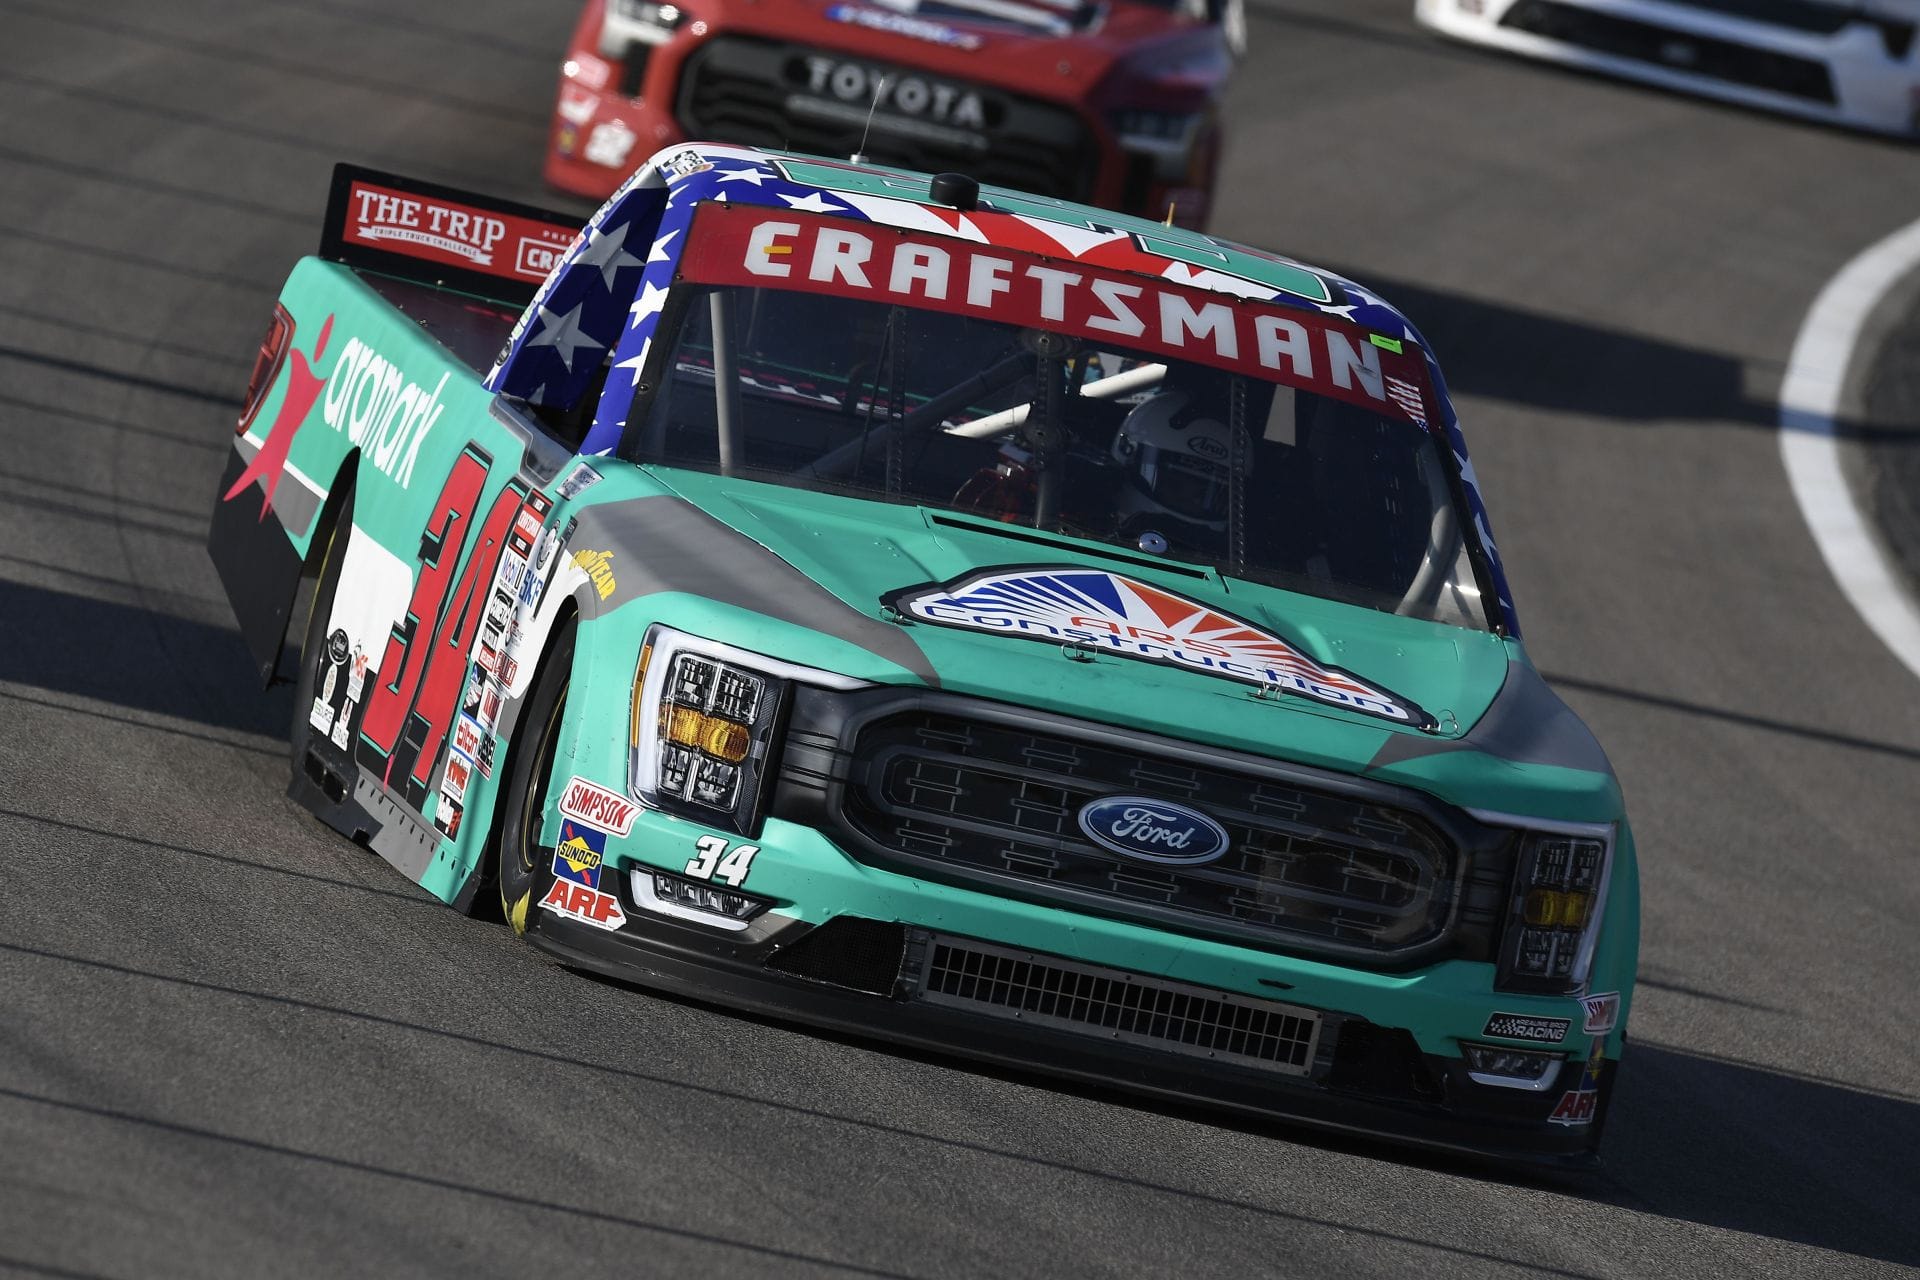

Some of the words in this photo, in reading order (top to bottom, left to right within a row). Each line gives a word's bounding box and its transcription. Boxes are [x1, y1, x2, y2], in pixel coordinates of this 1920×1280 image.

[807, 56, 984, 128] TOYOTA
[355, 189, 419, 227] THE
[426, 205, 506, 252] TRIP
[374, 227, 404, 239] TRIPLE
[405, 231, 431, 243] TRUCK
[744, 221, 1388, 402] CRAFTSMAN
[323, 336, 450, 490] aramark
[518, 568, 545, 609] SKF
[361, 450, 524, 784] 34
[1069, 617, 1232, 658] ARS
[567, 783, 635, 829] SIMPSON
[1111, 807, 1196, 849] Ford
[559, 842, 599, 868] SUNOCO
[685, 835, 760, 888] 34
[1515, 1025, 1566, 1040] RACING
